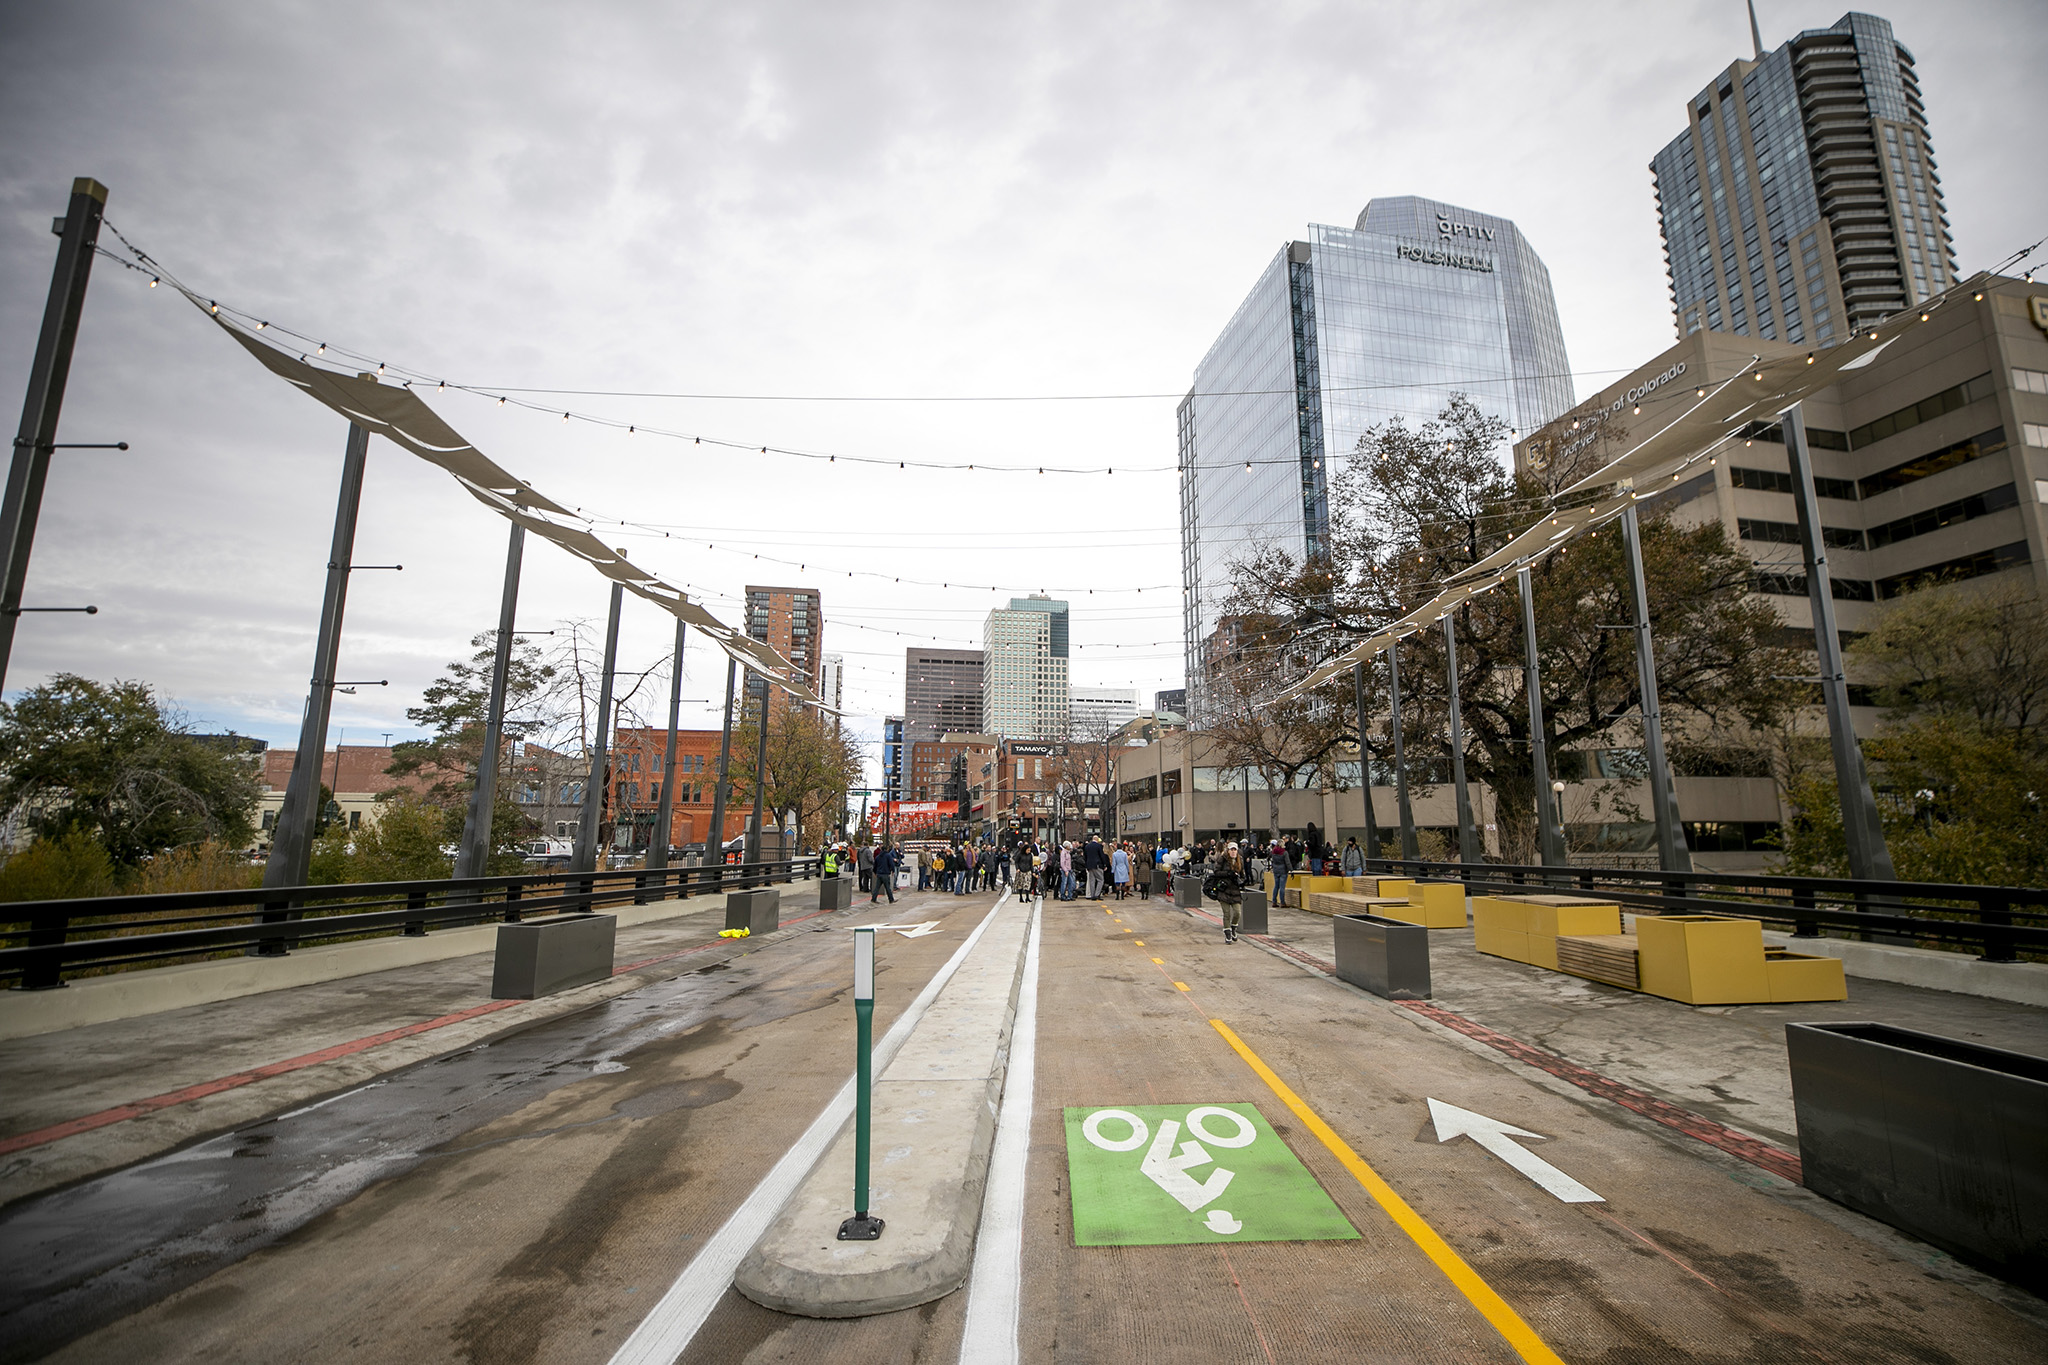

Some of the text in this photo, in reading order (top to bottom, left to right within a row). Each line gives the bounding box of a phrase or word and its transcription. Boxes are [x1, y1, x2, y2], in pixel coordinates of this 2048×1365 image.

[1438, 219, 1496, 241] OPTIV
[1397, 244, 1494, 273] POLSINELLI
[1612, 393, 1626, 412] of
[1627, 361, 1687, 403] Colorado
